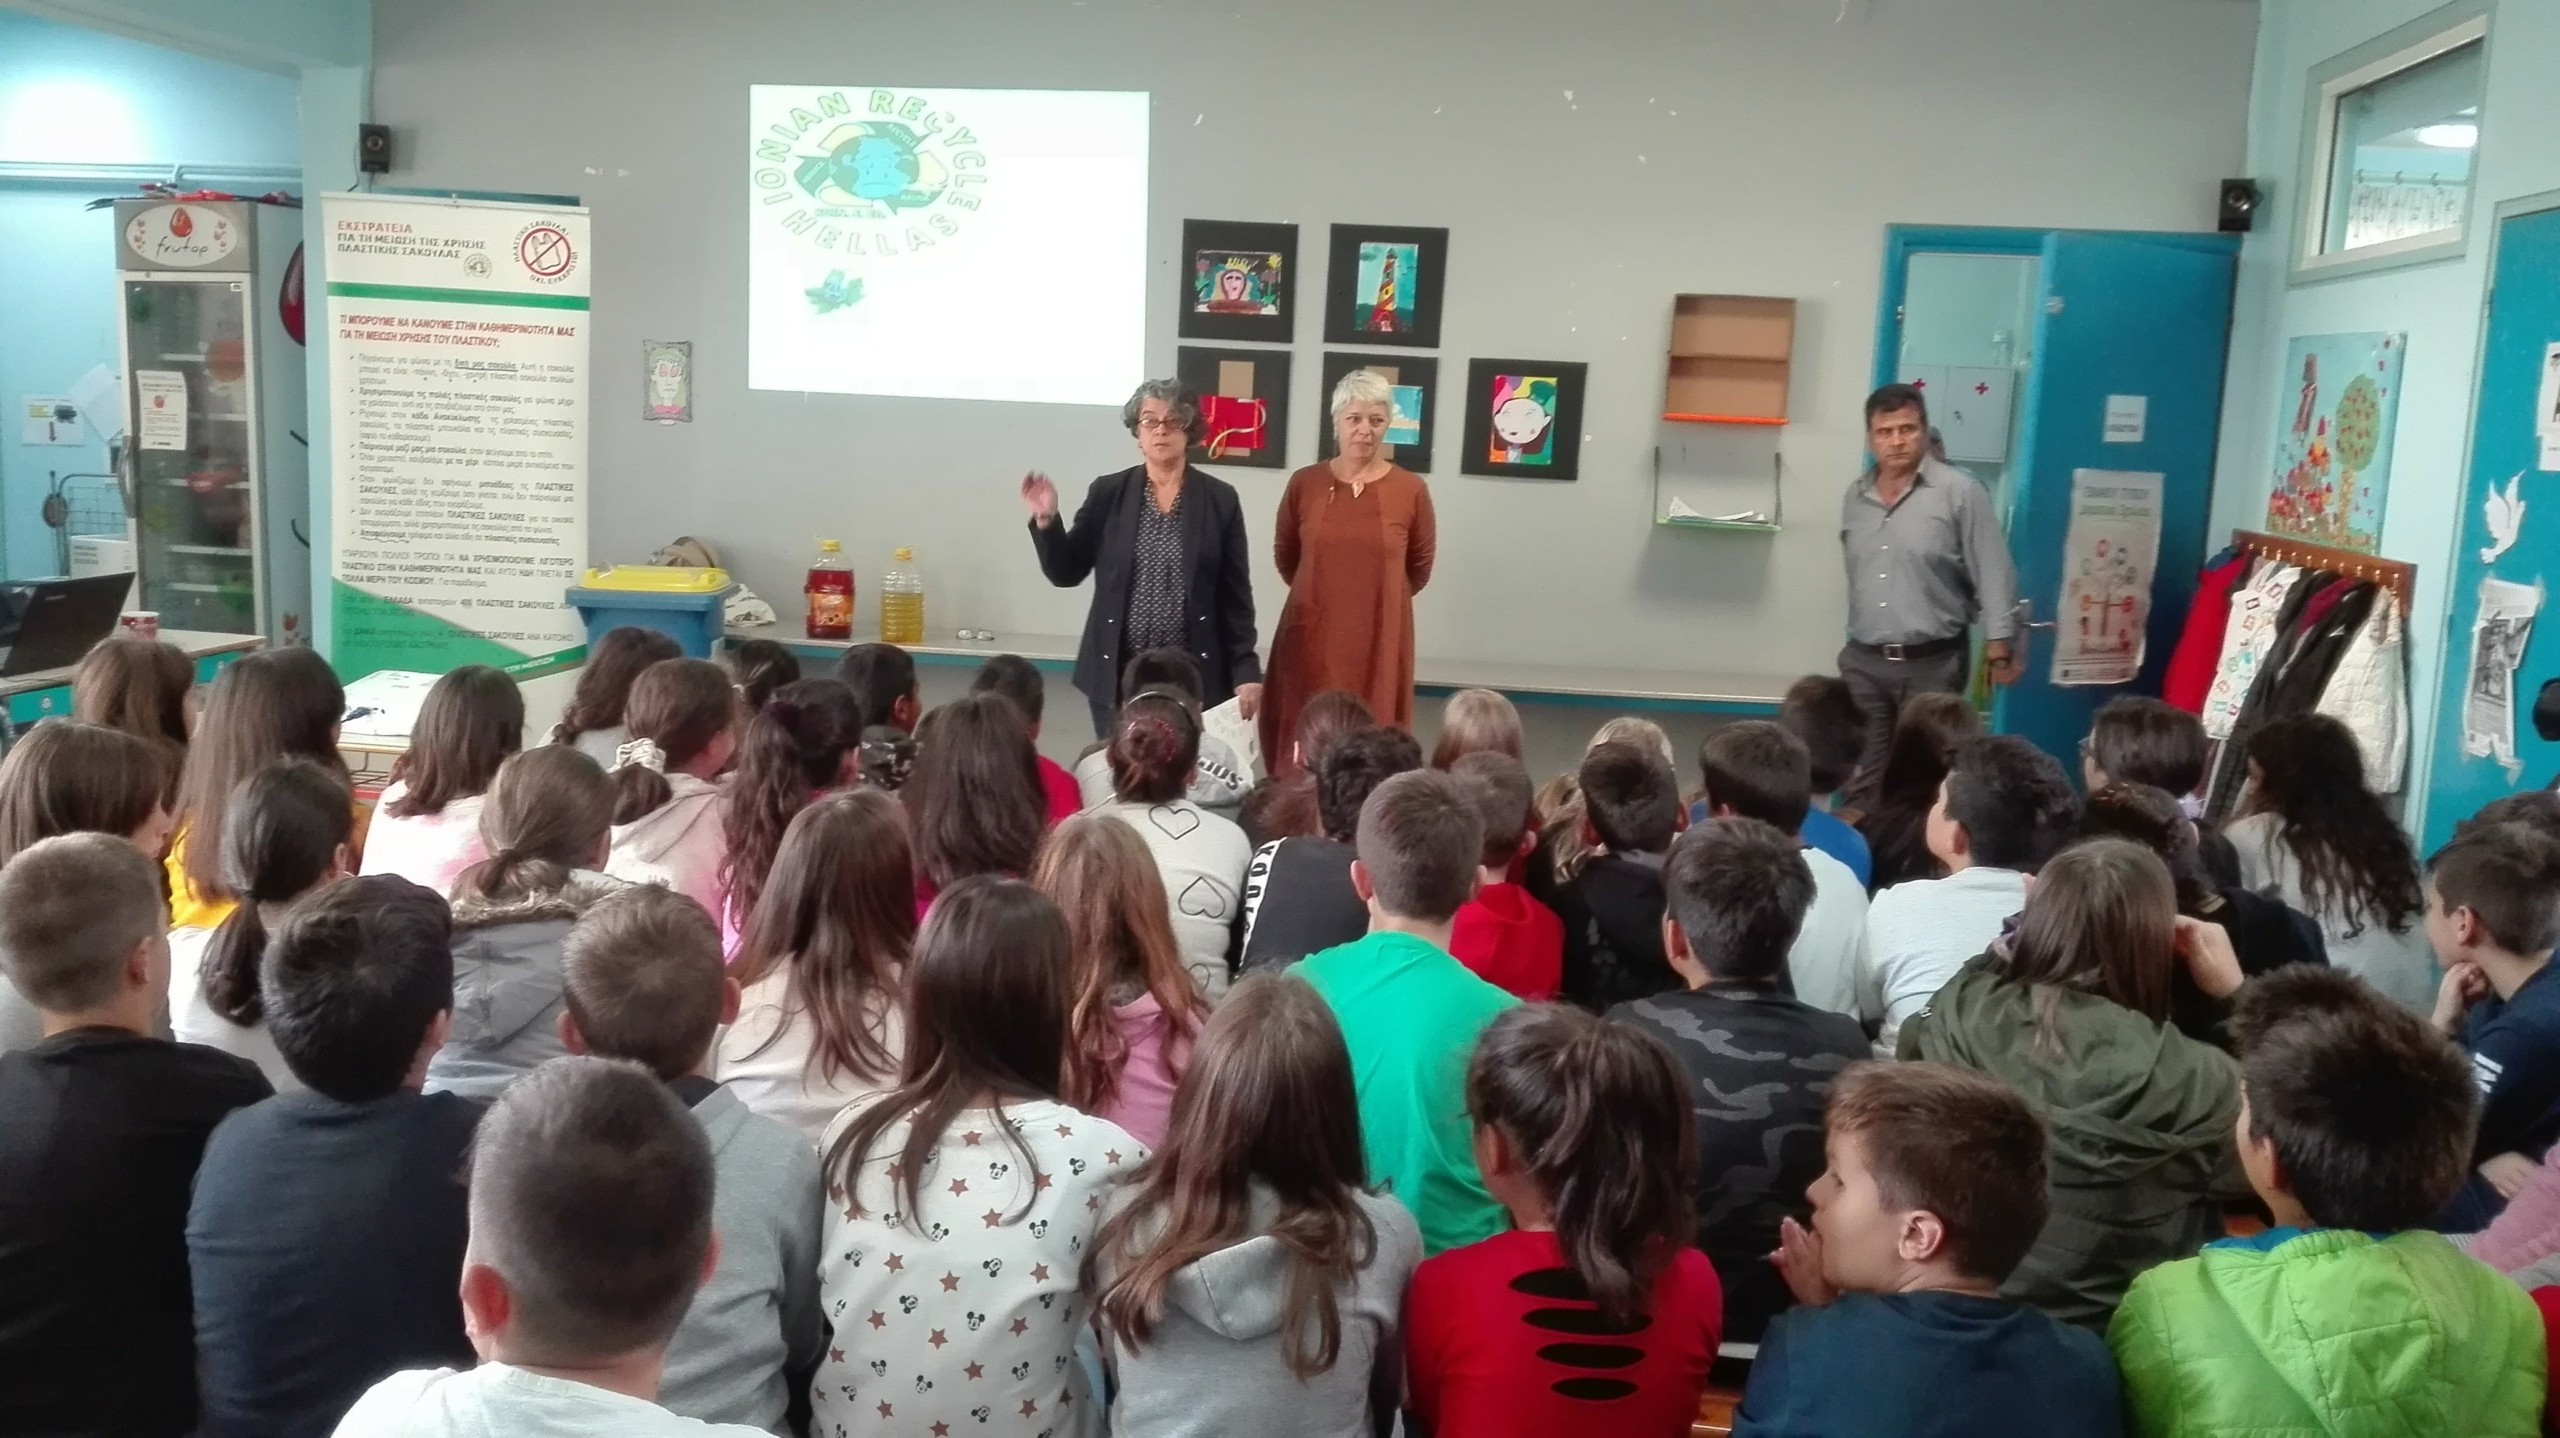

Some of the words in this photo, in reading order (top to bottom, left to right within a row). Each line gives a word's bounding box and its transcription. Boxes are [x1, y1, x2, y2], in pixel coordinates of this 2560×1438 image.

[755, 91, 851, 206] IONIAN
[868, 89, 988, 212] RECYCLE
[337, 220, 414, 233] ΕΚΣΤΡΑΤΕΙΑ
[781, 208, 959, 257] HELLAS
[155, 236, 209, 258] frutop
[337, 233, 355, 242] ΓΙΑ
[358, 234, 372, 243] ΤΗ
[374, 235, 416, 245] ΜΕΙΩΣΗ
[418, 237, 440, 247] ΤΗΣ
[443, 239, 487, 250] ΧΡΗΣΗΣ
[337, 243, 399, 255] ΠΛΑΣΤΙΚΗΣ
[401, 246, 461, 259] ΣΑΚΟΥΛΑΣ
[348, 316, 395, 327] ΜΠΟΡΟΥΜΕ
[397, 317, 409, 328] ΝΑ
[411, 318, 454, 330] ΚΑΝΟΥΜΕ
[455, 320, 477, 331] ΣΤΗΝ
[478, 321, 555, 336] ΚΑΘΗΜΕΡΙΝΟΤΗΤΑ
[556, 326, 576, 337] ΜΑΣ
[339, 329, 352, 340] ΓΙΑ
[353, 330, 365, 340] ΤΗ
[366, 331, 397, 342] ΜΕΙΩΣΗ
[398, 333, 432, 343] ΧΡΗΣΗΣ
[433, 334, 450, 344] ΤΟΥ
